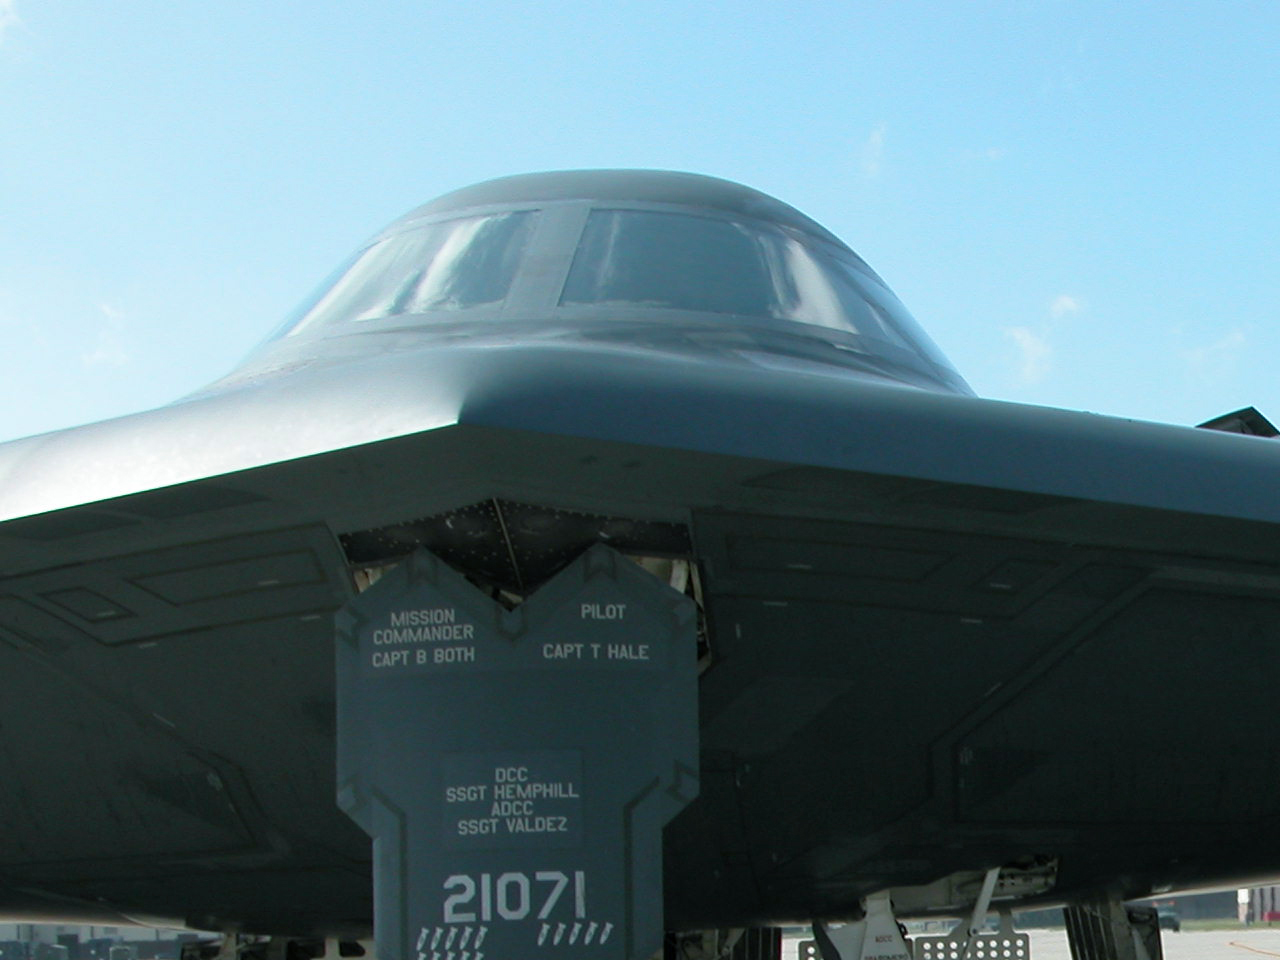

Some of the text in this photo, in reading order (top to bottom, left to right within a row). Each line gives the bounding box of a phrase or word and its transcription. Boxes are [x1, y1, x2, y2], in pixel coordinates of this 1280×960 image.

[390, 608, 455, 627] MISSION
[581, 603, 626, 619] PILOT
[373, 624, 475, 645] COMMANDER
[372, 647, 475, 667] CAPT B BOTH
[543, 643, 650, 660] CAPT T HALE
[495, 766, 528, 782] DCC
[446, 782, 580, 802] SSGT HEMPHILL
[491, 801, 534, 817] ADCC
[458, 816, 568, 836] SSGT VALDEZ
[443, 870, 586, 924] 21071
